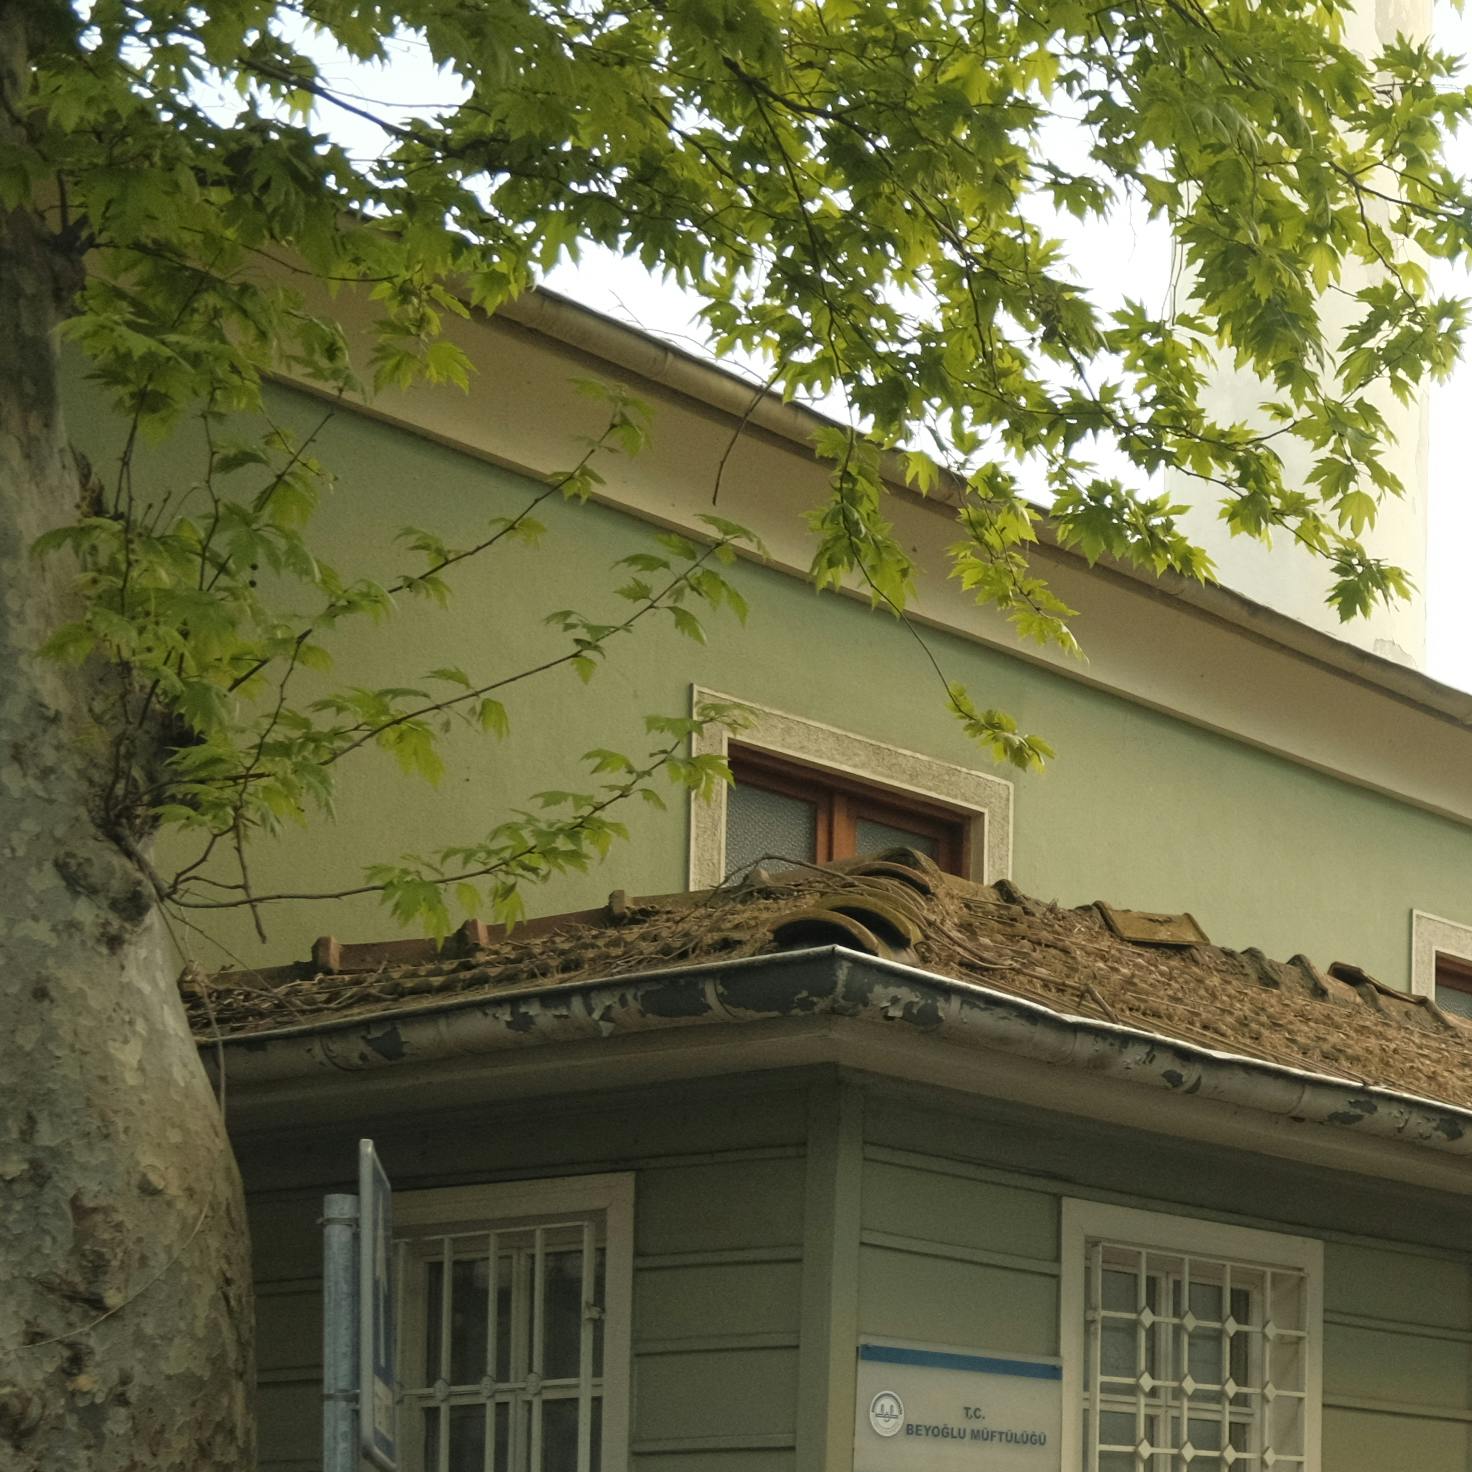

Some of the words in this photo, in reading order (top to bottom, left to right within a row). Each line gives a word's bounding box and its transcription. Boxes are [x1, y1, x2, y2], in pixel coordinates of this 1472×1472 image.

[964, 1406, 986, 1421] T.C.
[906, 1423, 966, 1440] BEYOĞLU
[970, 1428, 1047, 1446] MÜFTÜLÜĞÜ
